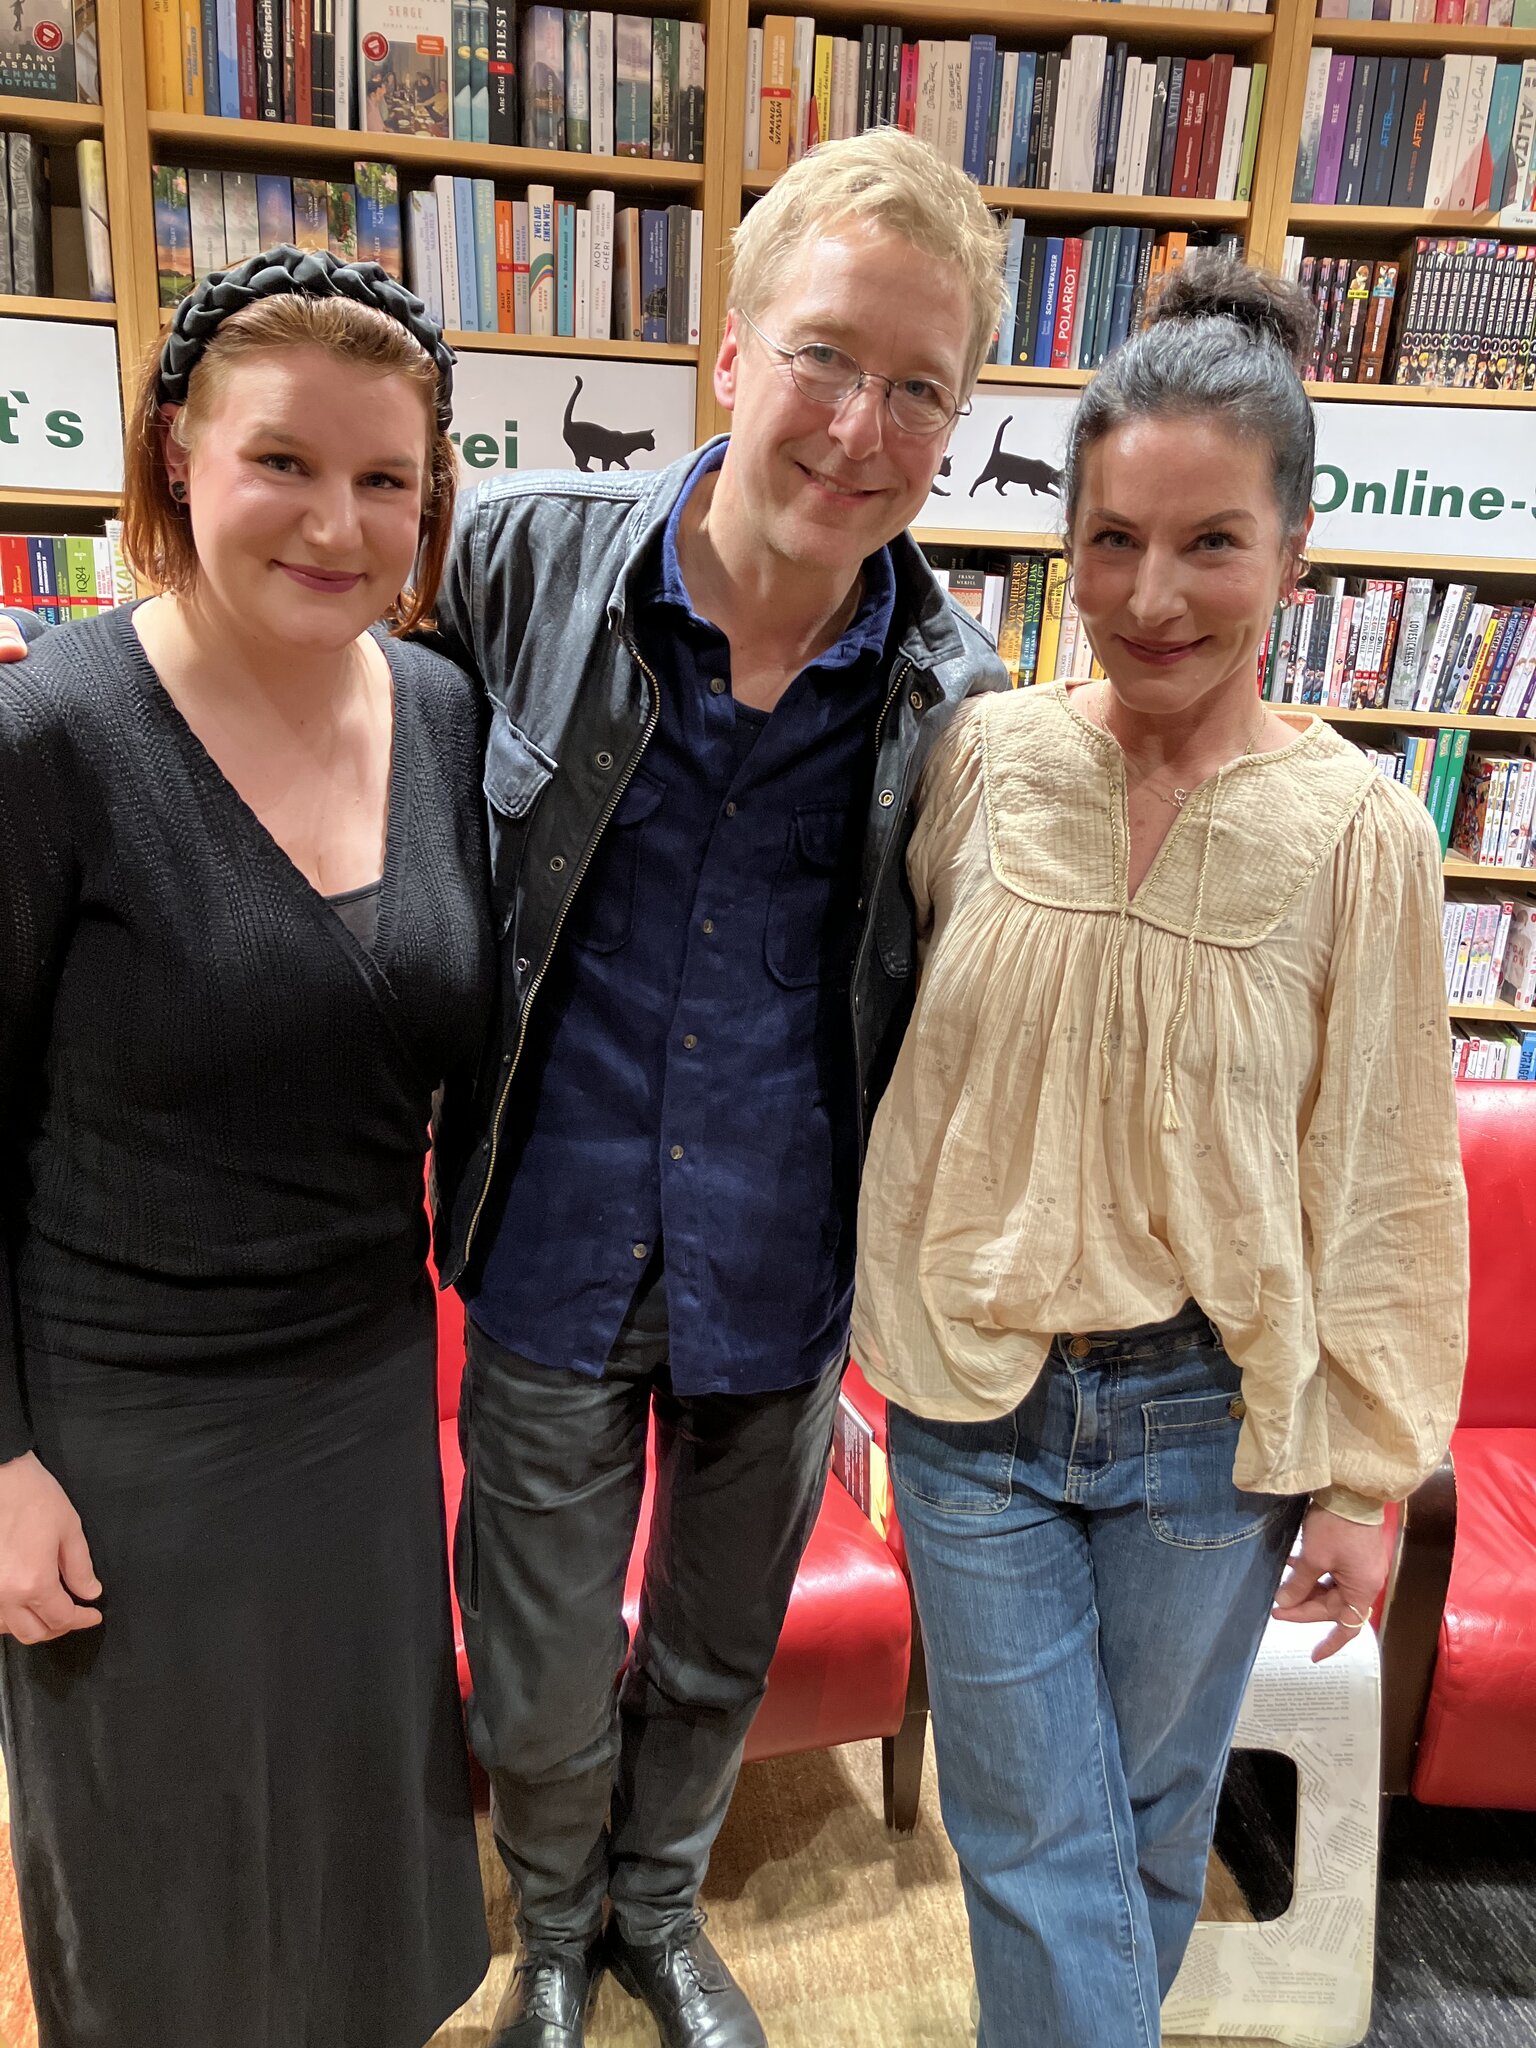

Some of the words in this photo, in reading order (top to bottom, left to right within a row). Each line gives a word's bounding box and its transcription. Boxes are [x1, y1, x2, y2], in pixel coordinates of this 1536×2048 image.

[388, 5, 423, 19] SERGE
[495, 7, 507, 60] BIEST
[1033, 76, 1043, 114] DAVID
[1186, 90, 1195, 105] der
[1331, 104, 1340, 124] RISE
[1337, 60, 1346, 82] FALL
[497, 98, 506, 115] Ane
[1183, 107, 1193, 126] Herr
[1195, 92, 1205, 124] Krähen
[1381, 111, 1393, 148] AFTER
[1412, 111, 1426, 148] AFTER
[1515, 102, 1534, 168] ALITA
[533, 206, 541, 220] AUF
[542, 204, 551, 221] WEG
[533, 221, 541, 239] ZWEI
[543, 221, 551, 242] EINEM
[593, 242, 602, 268] MON
[602, 242, 611, 271] CHÉRI
[1045, 254, 1058, 315] SCHMELZWASSER
[1058, 266, 1077, 339] POLARROT
[1311, 464, 1536, 520] Online-
[1013, 562, 1022, 577] BIS
[1028, 563, 1038, 580] DAS
[1010, 579, 1020, 602] HIER
[1019, 562, 1029, 601] ANFANG
[1026, 581, 1036, 600] AUF
[1007, 603, 1018, 623] VON
[1024, 602, 1034, 623] WAS
[1459, 591, 1472, 621] MAGUS
[1064, 626, 1076, 645] DIE
[1403, 620, 1420, 666] LOVESICKNESS
[1349, 639, 1357, 656] LOVE
